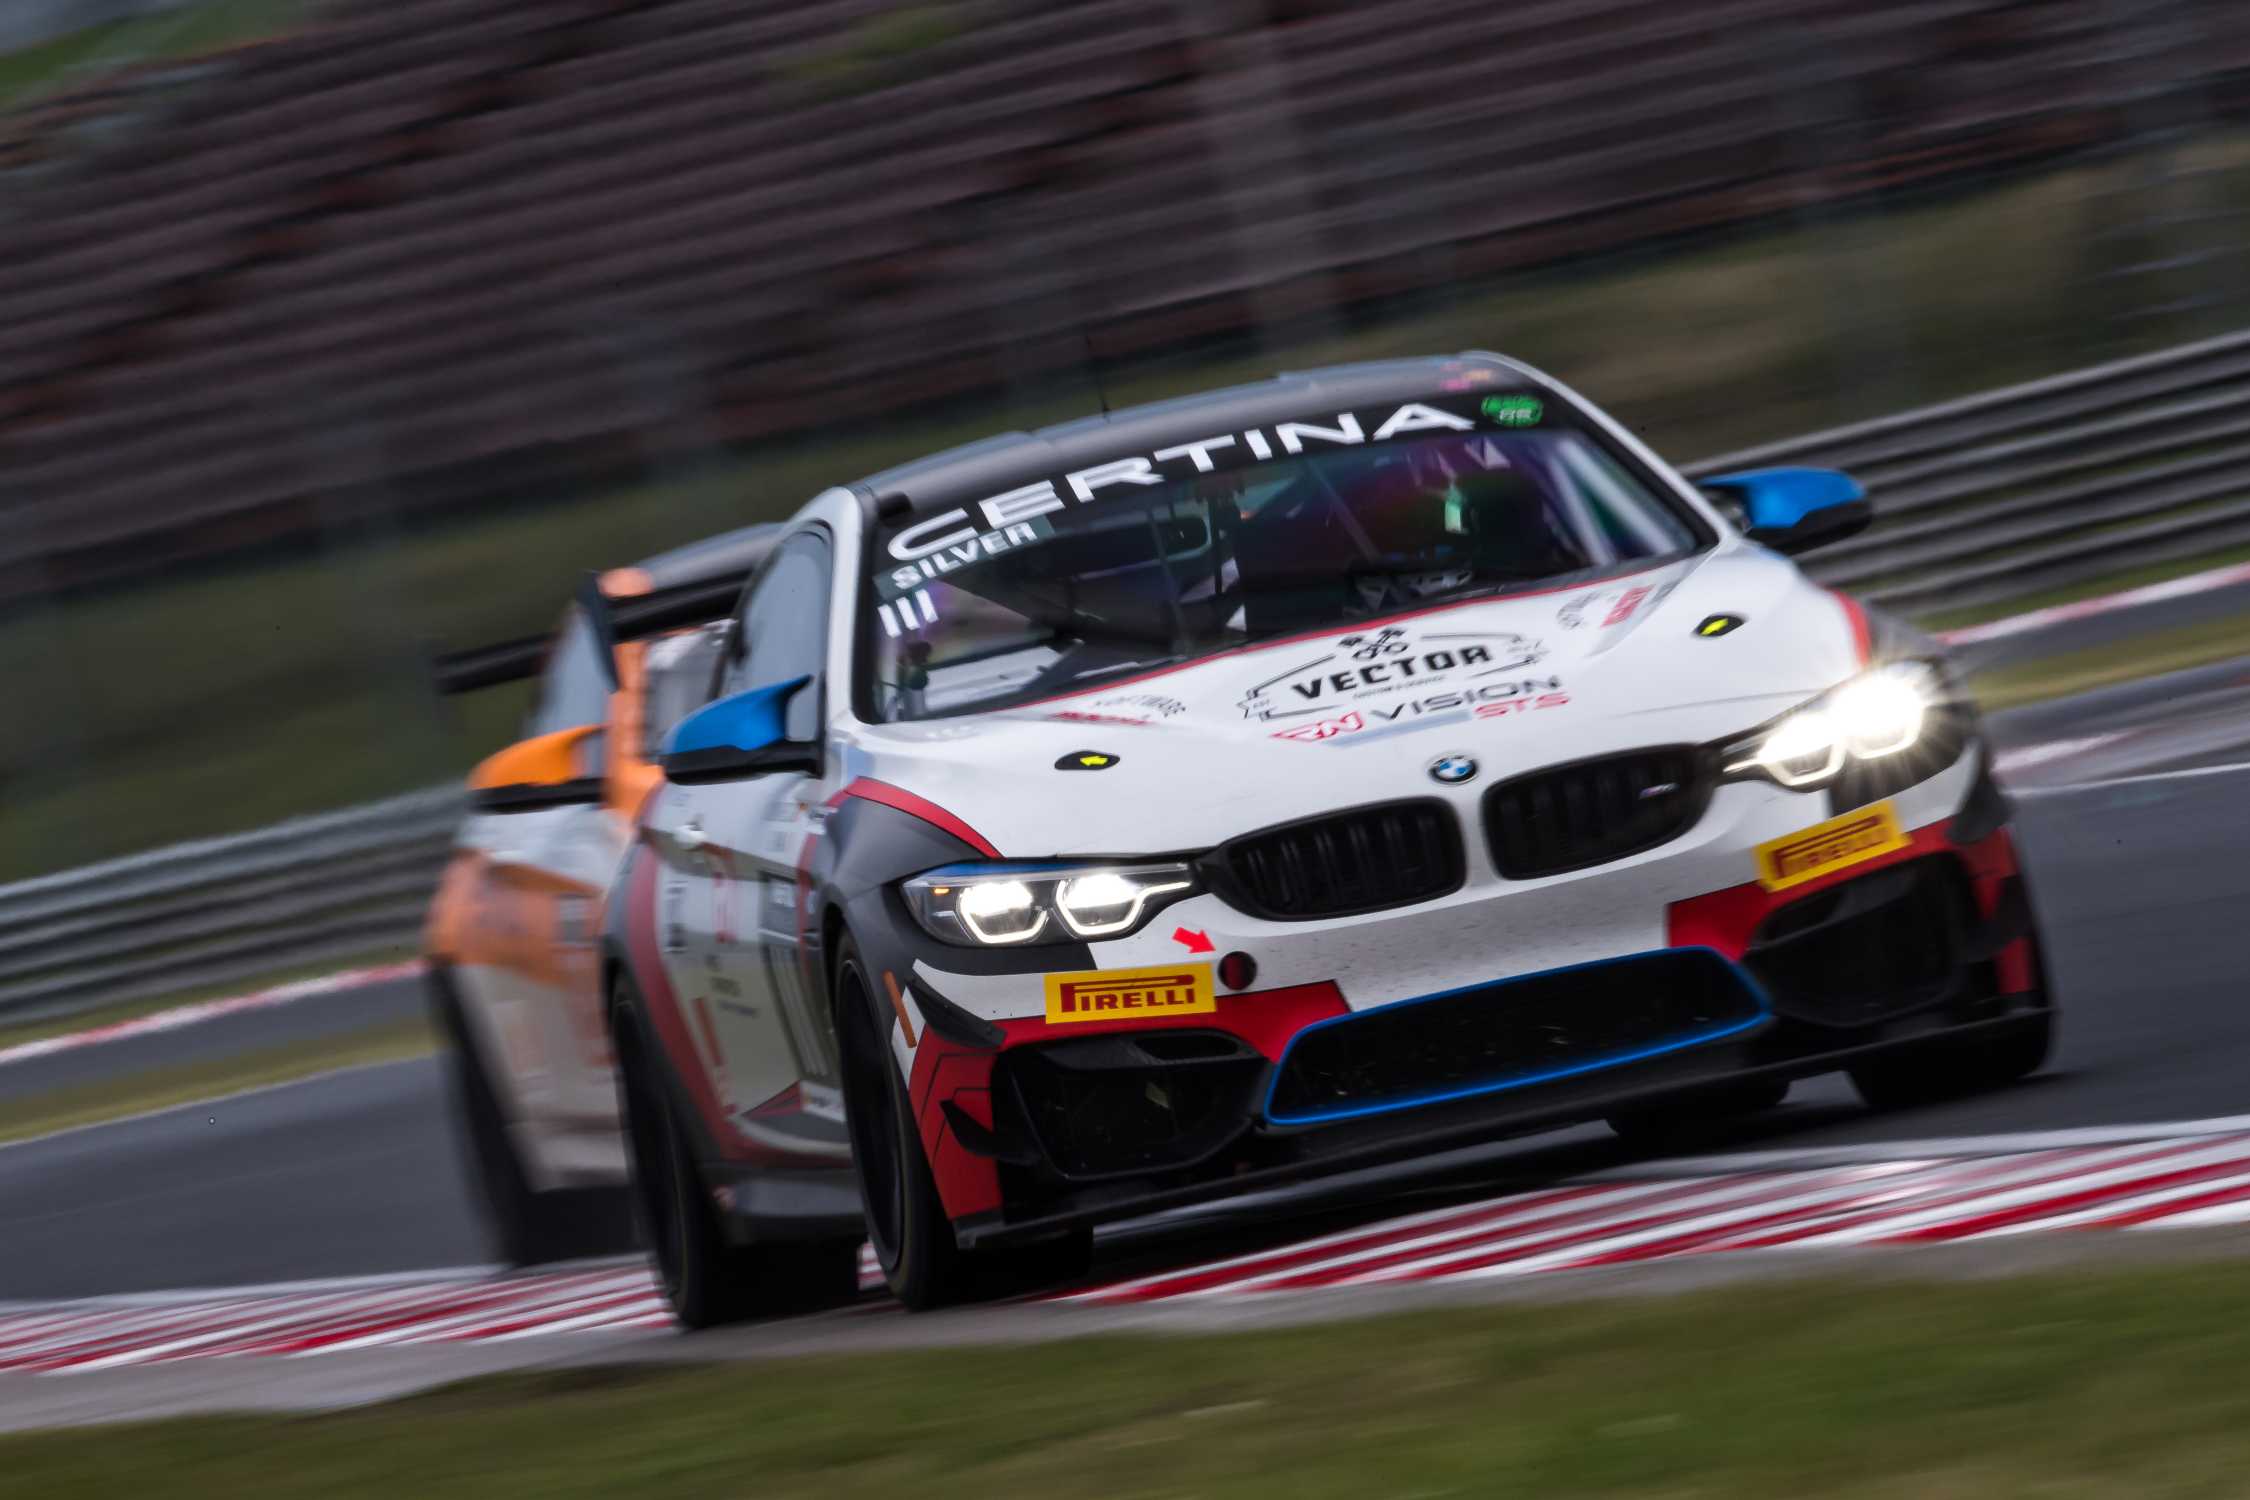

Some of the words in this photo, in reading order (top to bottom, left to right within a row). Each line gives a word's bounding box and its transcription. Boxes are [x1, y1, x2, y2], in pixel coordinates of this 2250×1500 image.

[887, 403, 1475, 561] CERTINA
[891, 521, 1038, 590] SILVER
[1291, 644, 1492, 700] VECTOR
[1369, 674, 1563, 721] VISION
[1474, 691, 1571, 719] STS
[1060, 974, 1196, 1013] PIRELLI
